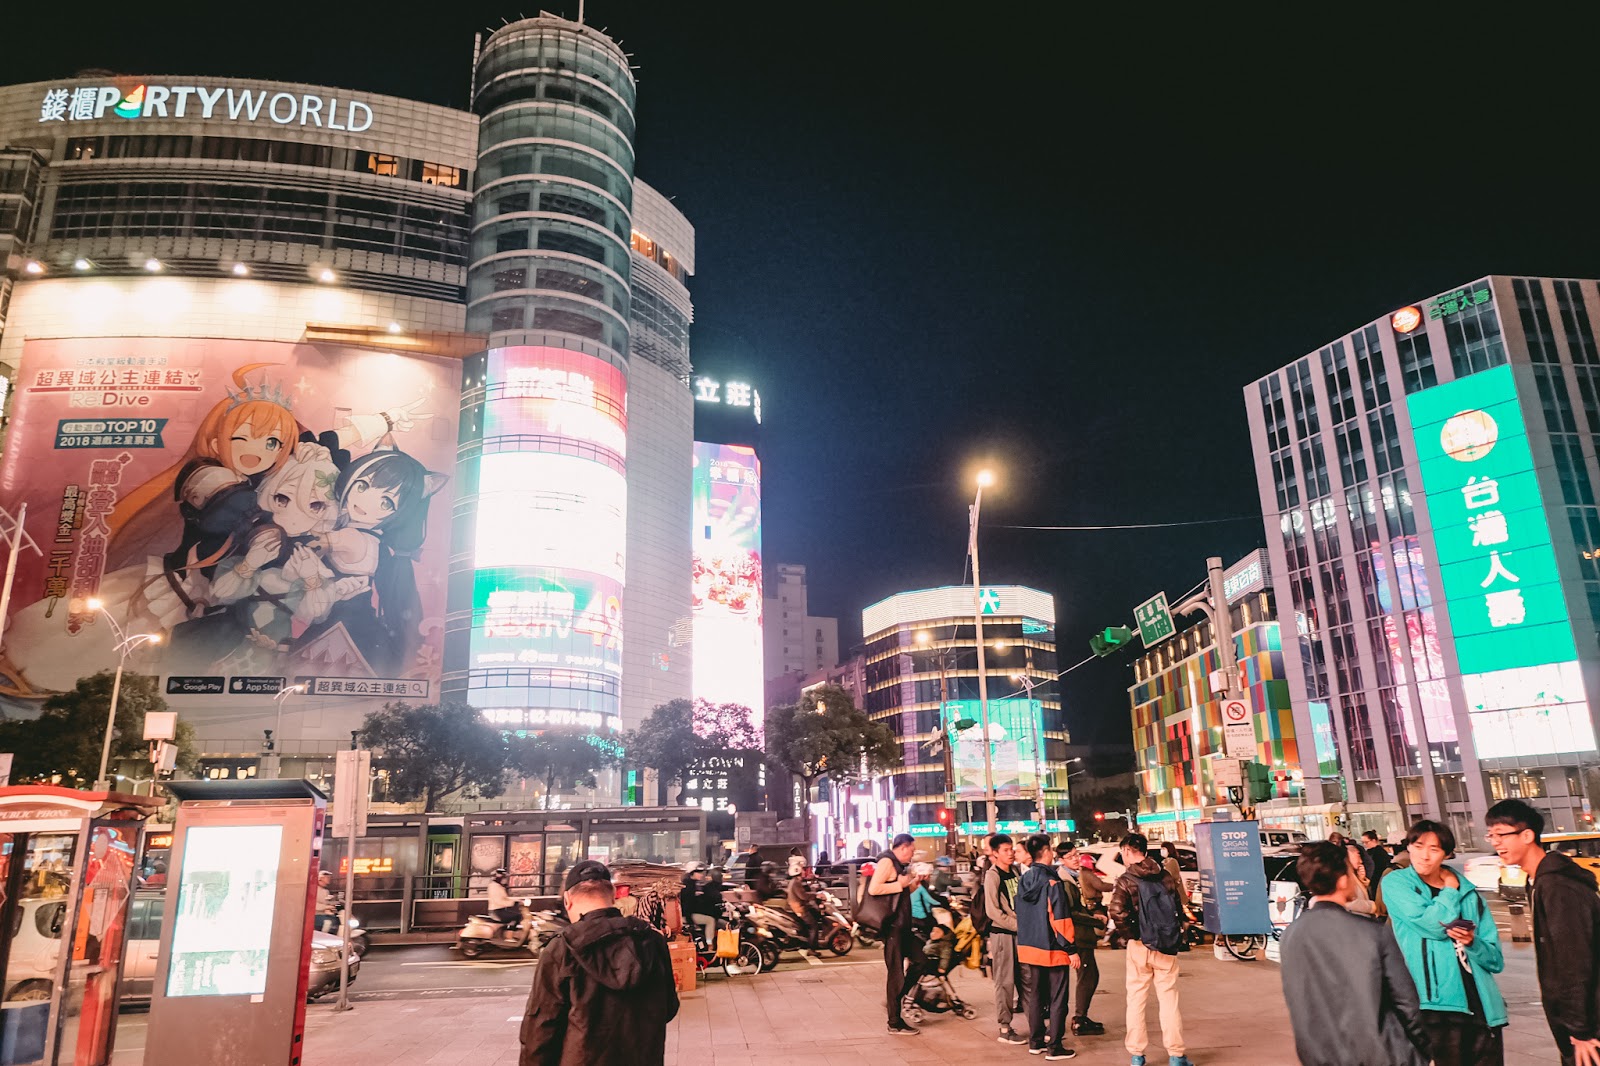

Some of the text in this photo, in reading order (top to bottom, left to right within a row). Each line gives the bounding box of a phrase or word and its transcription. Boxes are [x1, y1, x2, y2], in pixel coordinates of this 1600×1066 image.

[36, 370, 183, 387] 超異域公主連結
[106, 421, 138, 433] TOP
[140, 420, 156, 433] 10
[60, 436, 90, 446] 2018
[183, 683, 222, 691] Google Play
[246, 683, 262, 692] App
[317, 681, 408, 694] 超異域公主連結
[793, 781, 801, 818] AIGLE
[36, 809, 71, 818] PHONE
[1221, 831, 1248, 840] STOP
[1222, 840, 1249, 848] ORGAN
